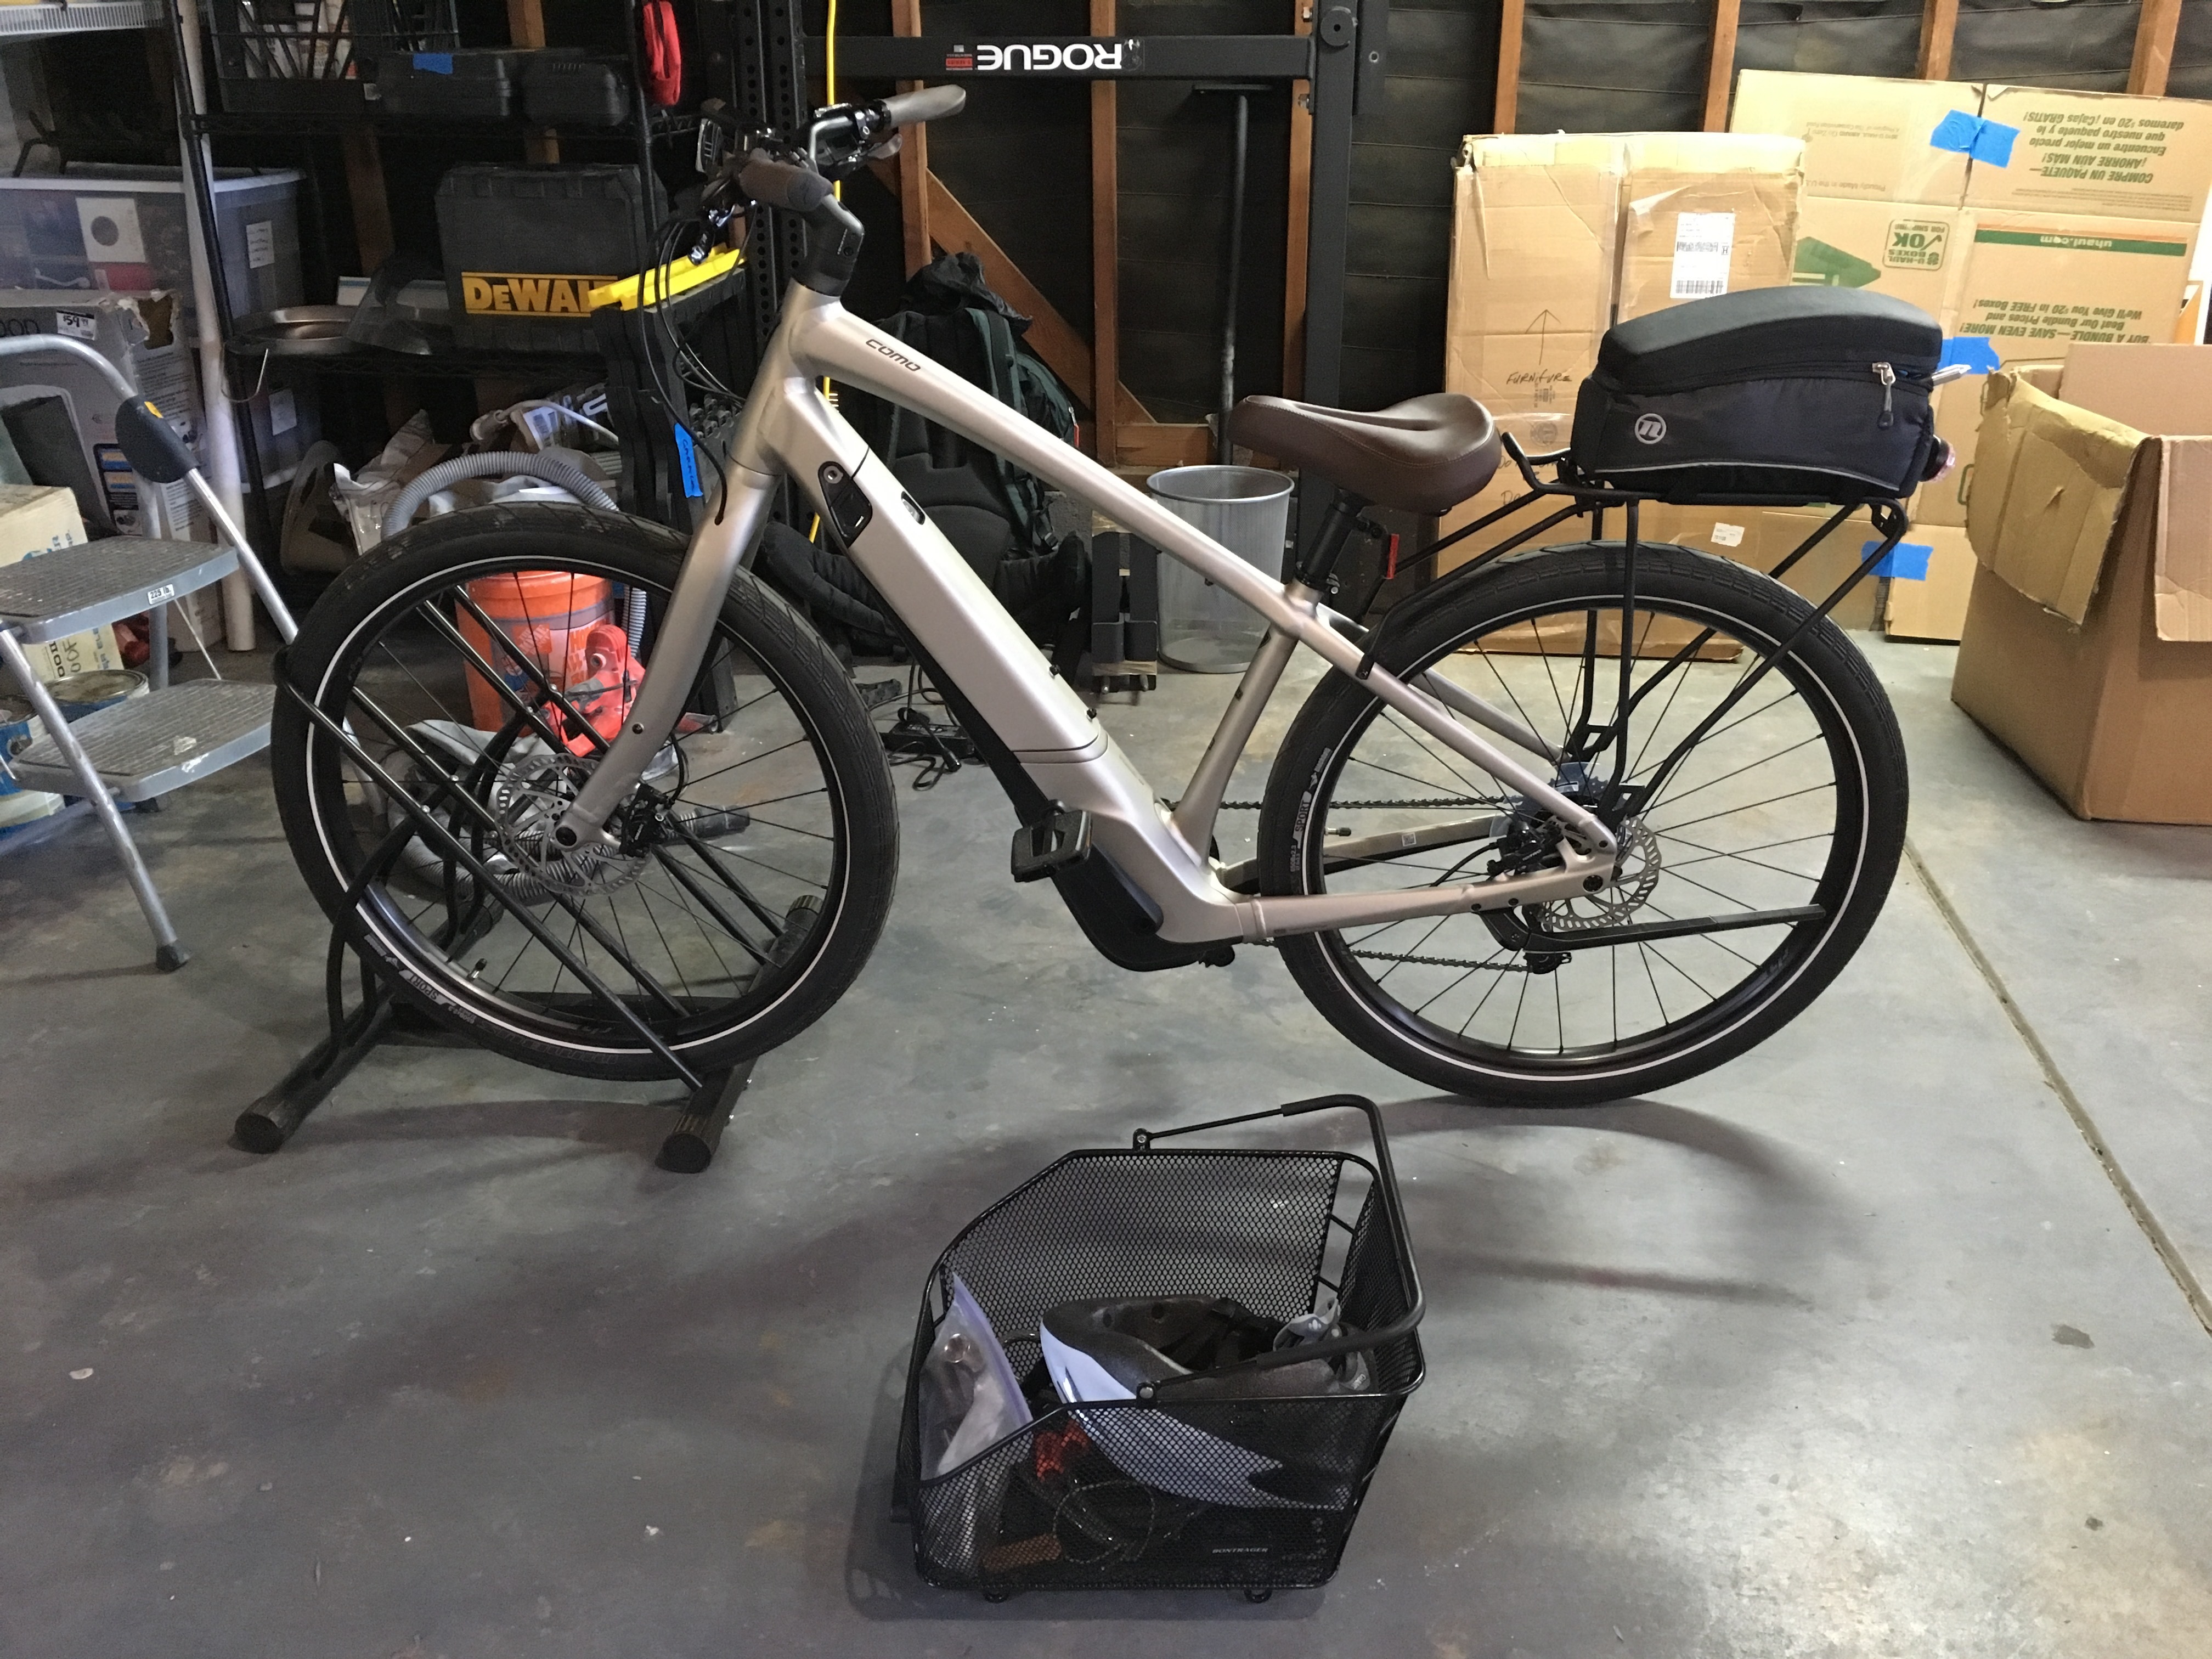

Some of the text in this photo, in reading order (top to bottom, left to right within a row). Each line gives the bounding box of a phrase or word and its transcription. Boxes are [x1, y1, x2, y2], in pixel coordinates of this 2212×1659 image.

[977, 43, 1122, 71] ROGUE
[2023, 111, 2065, 125] GRATIS!
[2102, 117, 2117, 126] en
[2138, 119, 2184, 131] daremos
[2036, 125, 2165, 142] que nuestro paquete y le
[2029, 138, 2166, 156] Encuentre un mejor precio
[2089, 170, 2106, 180] UN
[2108, 171, 2153, 184] COMPRE
[1892, 232, 1925, 249] OK
[2040, 235, 2113, 249] uhaul.com
[1888, 249, 1926, 257] BOXES
[1887, 256, 1925, 264] U-HAUL
[1972, 299, 2009, 311] Boxes!
[2011, 301, 2037, 313] FREE
[2039, 303, 2050, 313] in
[2071, 306, 2090, 316] You
[2092, 307, 2115, 318] Give
[2117, 309, 2142, 320] We'll
[1985, 312, 2125, 331] Beat Our Bundle Prices and
[1959, 323, 1997, 335] MORE!
[1999, 324, 2027, 337] EVEN
[2116, 333, 2126, 342] A
[2126, 334, 2150, 344] BUY
[150, 589, 162, 599] 225
[1294, 799, 1310, 832] SPORT
[407, 972, 439, 1000] SPORT
